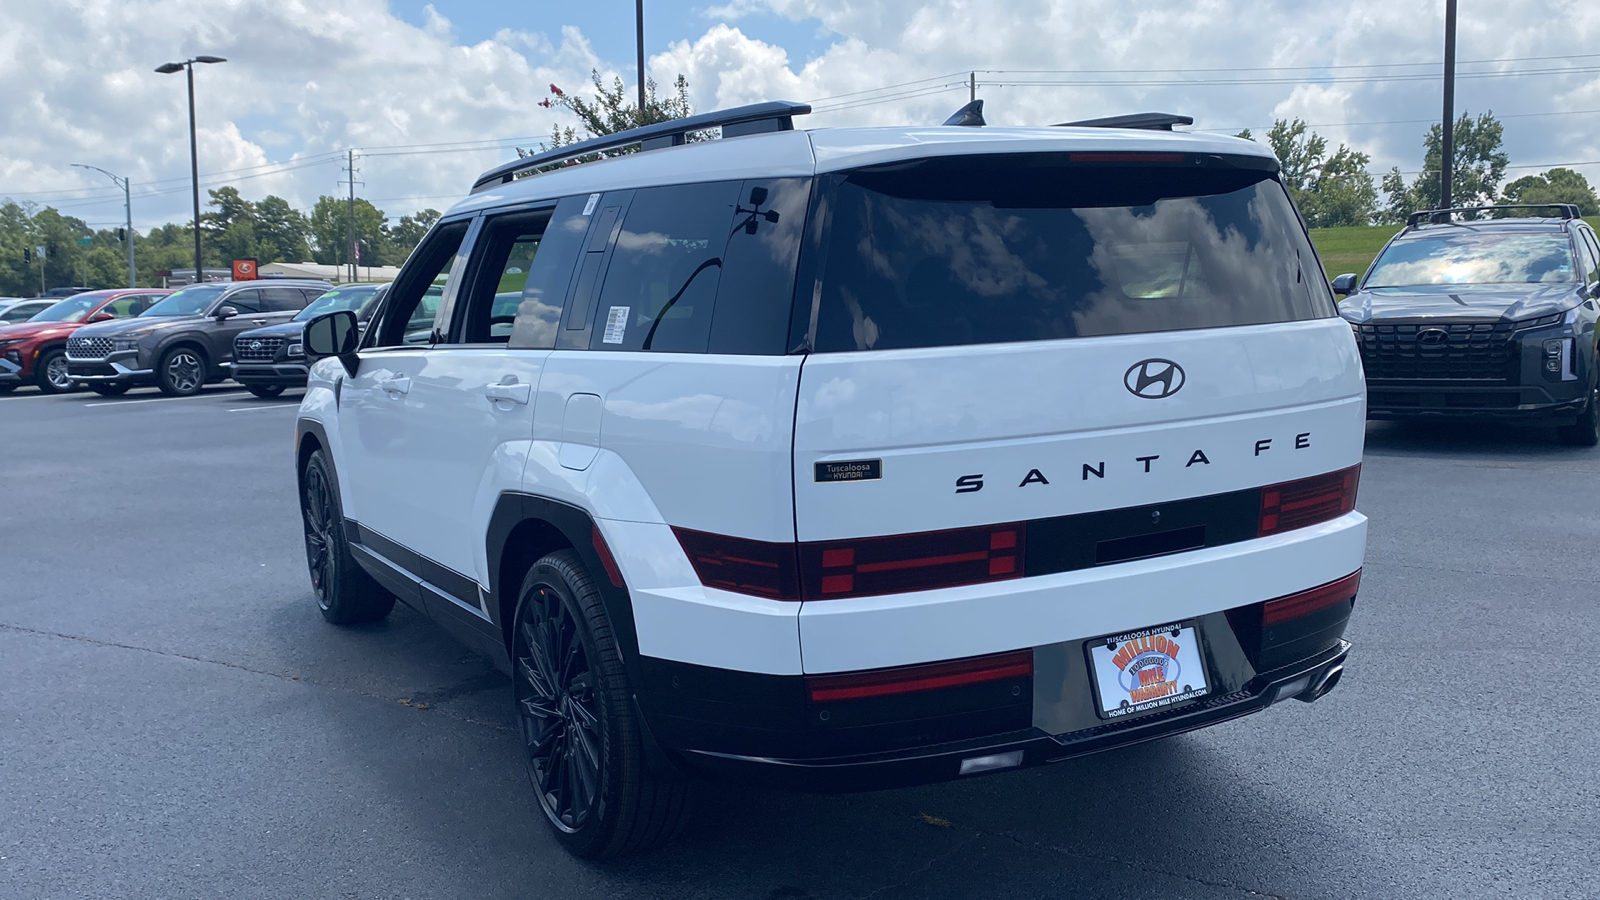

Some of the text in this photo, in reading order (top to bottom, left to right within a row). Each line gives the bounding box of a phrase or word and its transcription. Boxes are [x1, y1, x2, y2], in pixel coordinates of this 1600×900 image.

[826, 463, 871, 472] Tuscaloosa
[955, 432, 1311, 494] SANTA FE
[833, 471, 863, 479] HYUNDAI
[1107, 623, 1181, 644] TUSCALOOSA HYUNDAI
[1112, 635, 1180, 671] MILLION
[1138, 667, 1165, 686] MILE
[1130, 680, 1178, 703] WARRANTY
[1108, 708, 1126, 718] HOME
[1135, 701, 1159, 712] MILLION
[1159, 698, 1171, 706] MILE
[1170, 689, 1208, 703] HYUNDAI.COM
